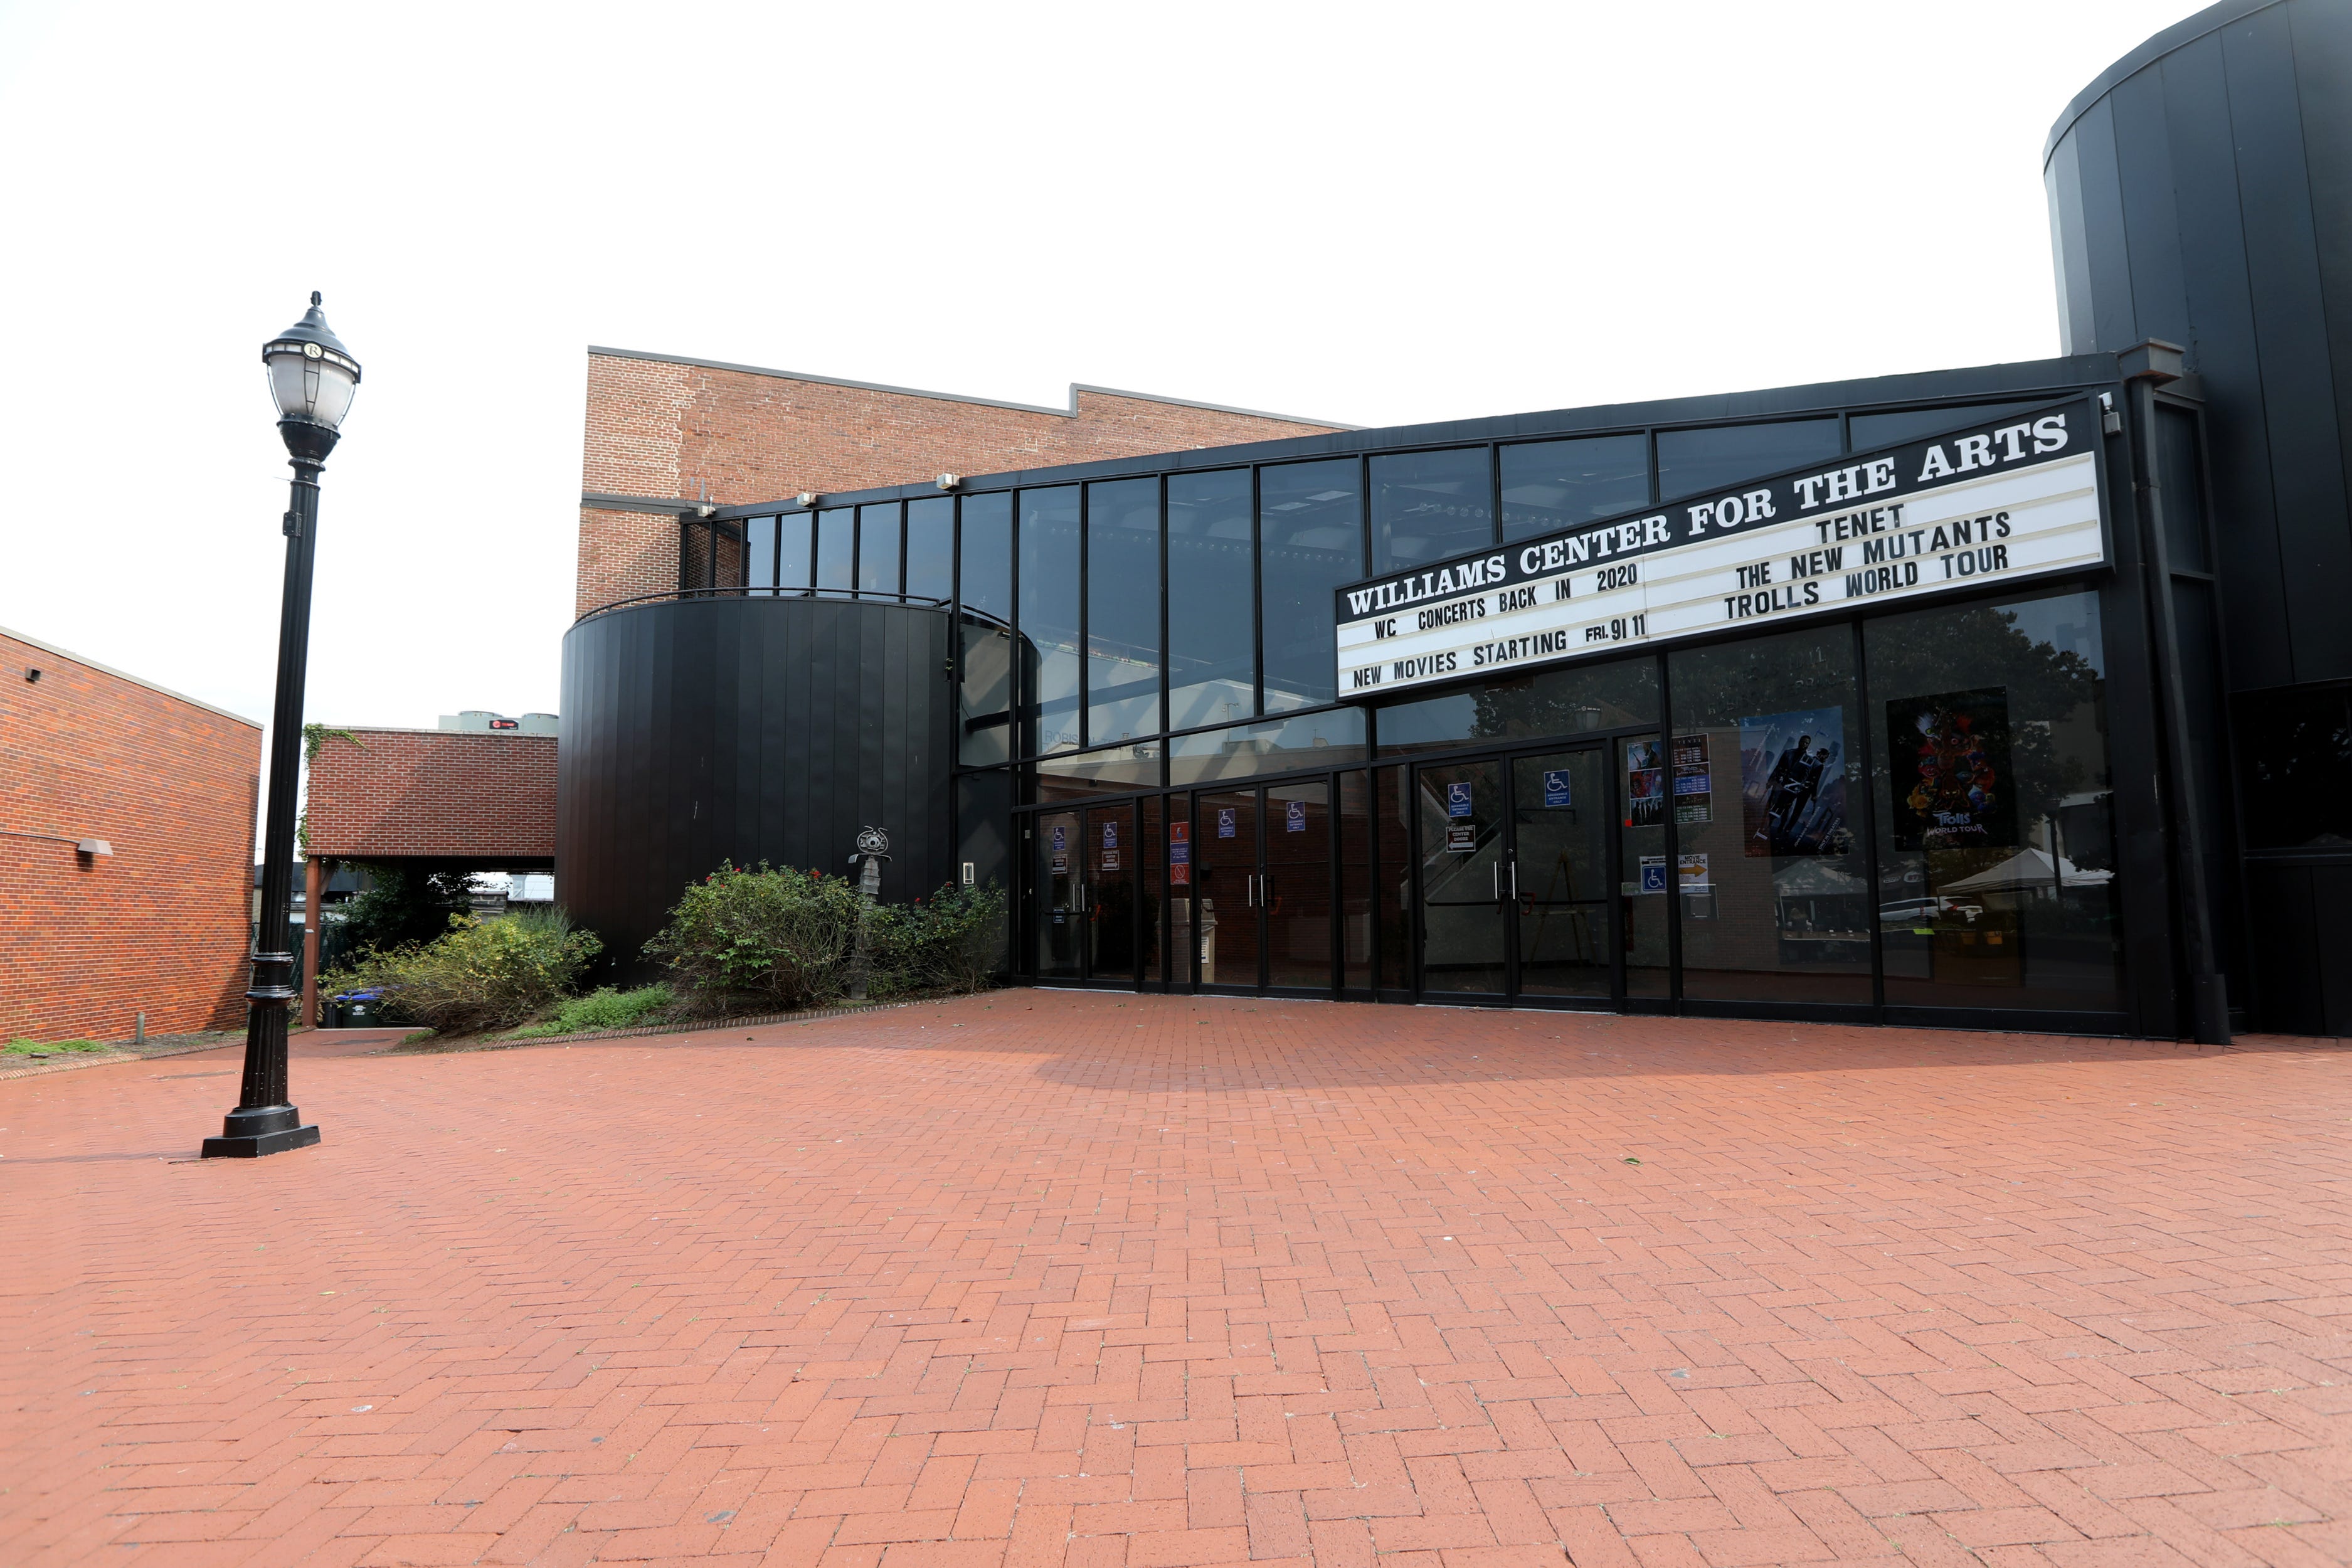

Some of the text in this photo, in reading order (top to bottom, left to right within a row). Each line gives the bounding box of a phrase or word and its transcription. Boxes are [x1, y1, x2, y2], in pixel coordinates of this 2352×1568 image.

[1347, 414, 2069, 615] WILLIAMS CENTER FOR THE ARTS
[1736, 512, 2011, 590] THE NEW MUTANTS
[1816, 504, 1904, 544] TENET
[1375, 563, 1638, 640] WC CONCERTS BACK IN 2020
[1725, 544, 2008, 620] TROLLS WORLD TOUR
[1353, 666, 1382, 689] NEW
[1394, 652, 1457, 681] MOVIES
[1474, 630, 1567, 665] STARTING
[1927, 824, 1988, 836] WORLD TOUR
